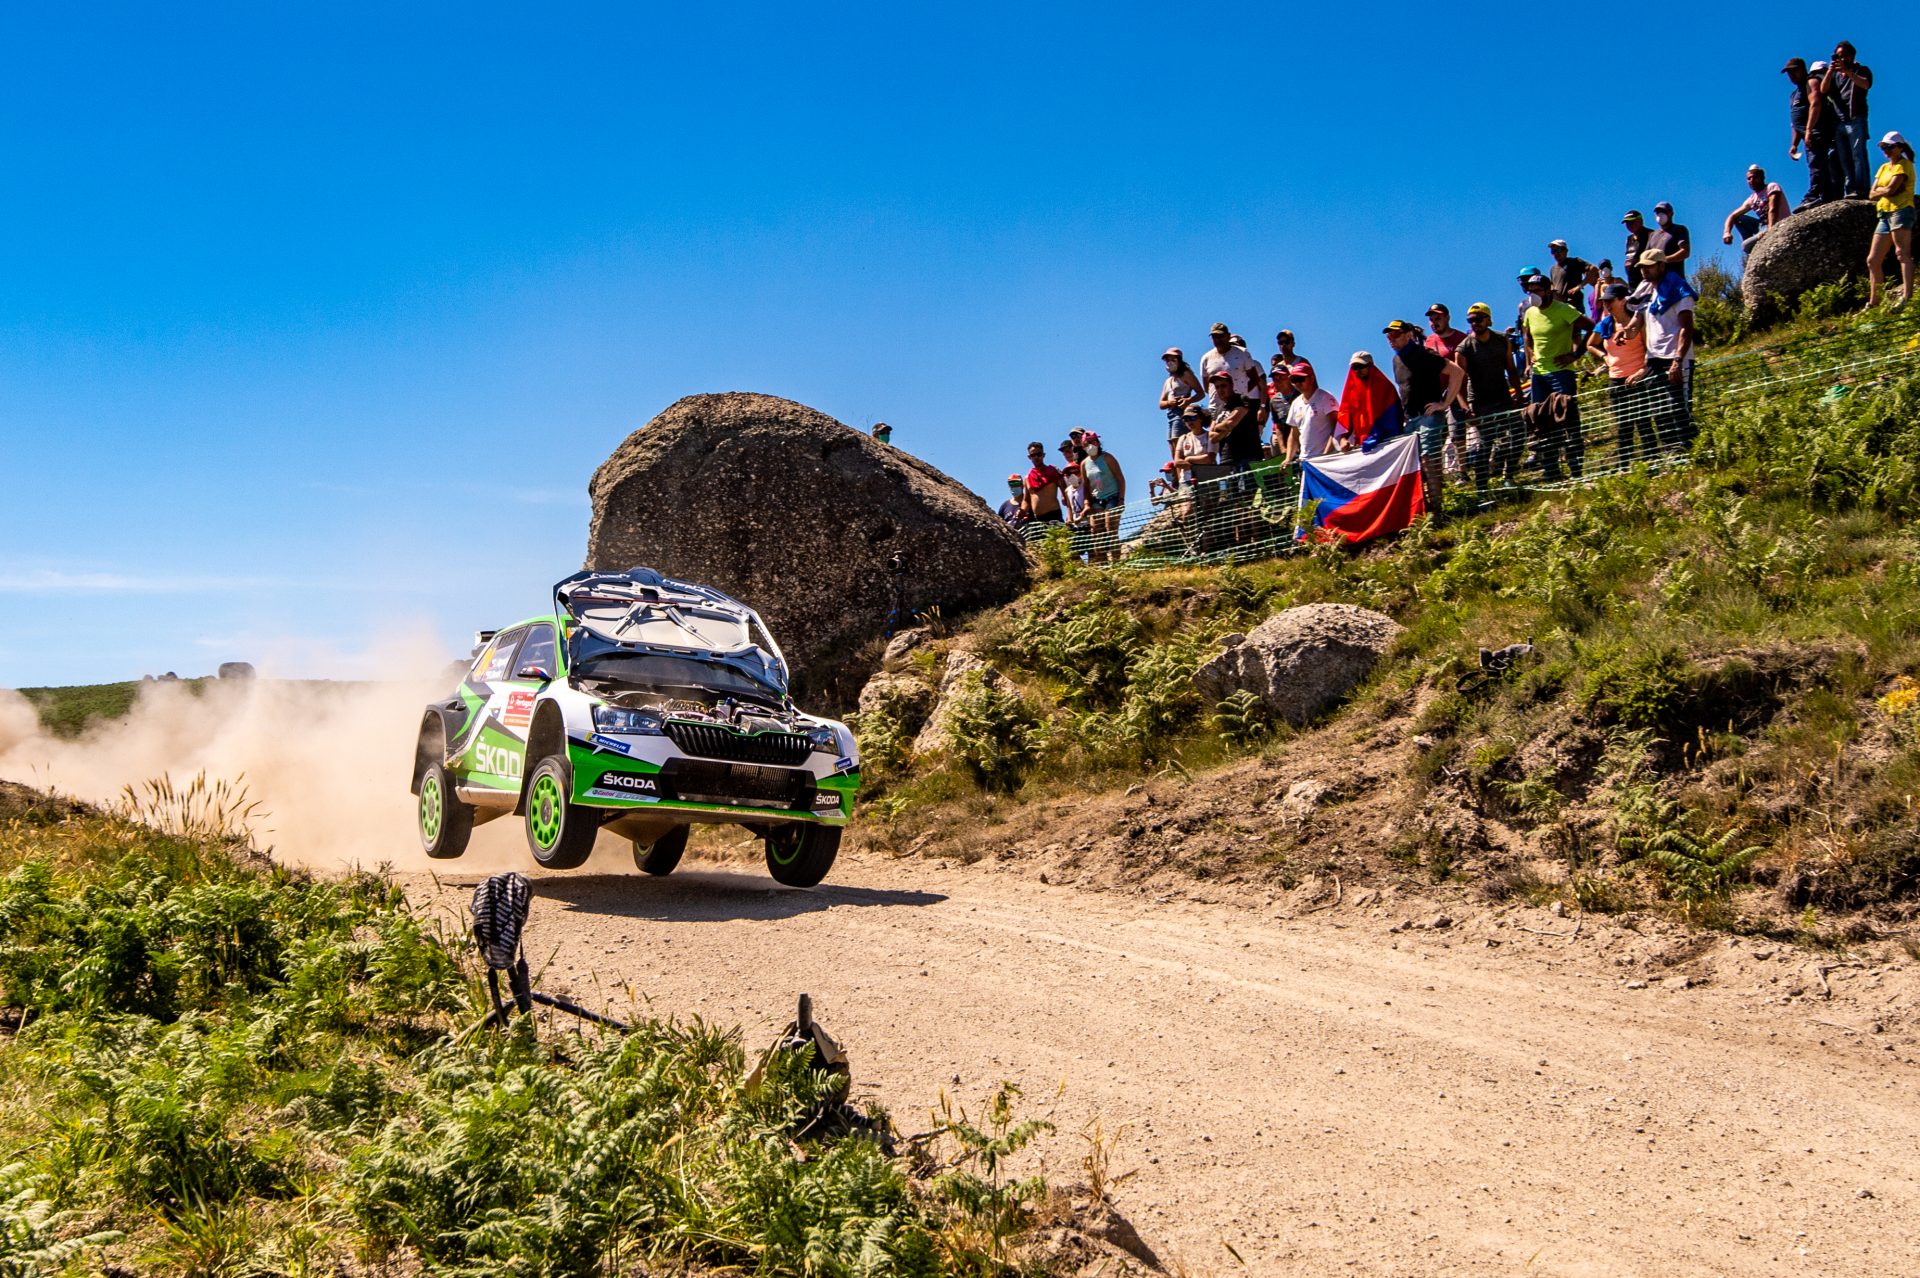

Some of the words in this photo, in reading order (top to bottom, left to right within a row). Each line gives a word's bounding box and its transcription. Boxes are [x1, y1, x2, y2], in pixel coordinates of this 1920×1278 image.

[598, 738, 627, 750] MICHELIN
[475, 735, 522, 781] ŠKOD
[603, 772, 656, 790] ŠKODA
[815, 793, 840, 805] ŠKODA
